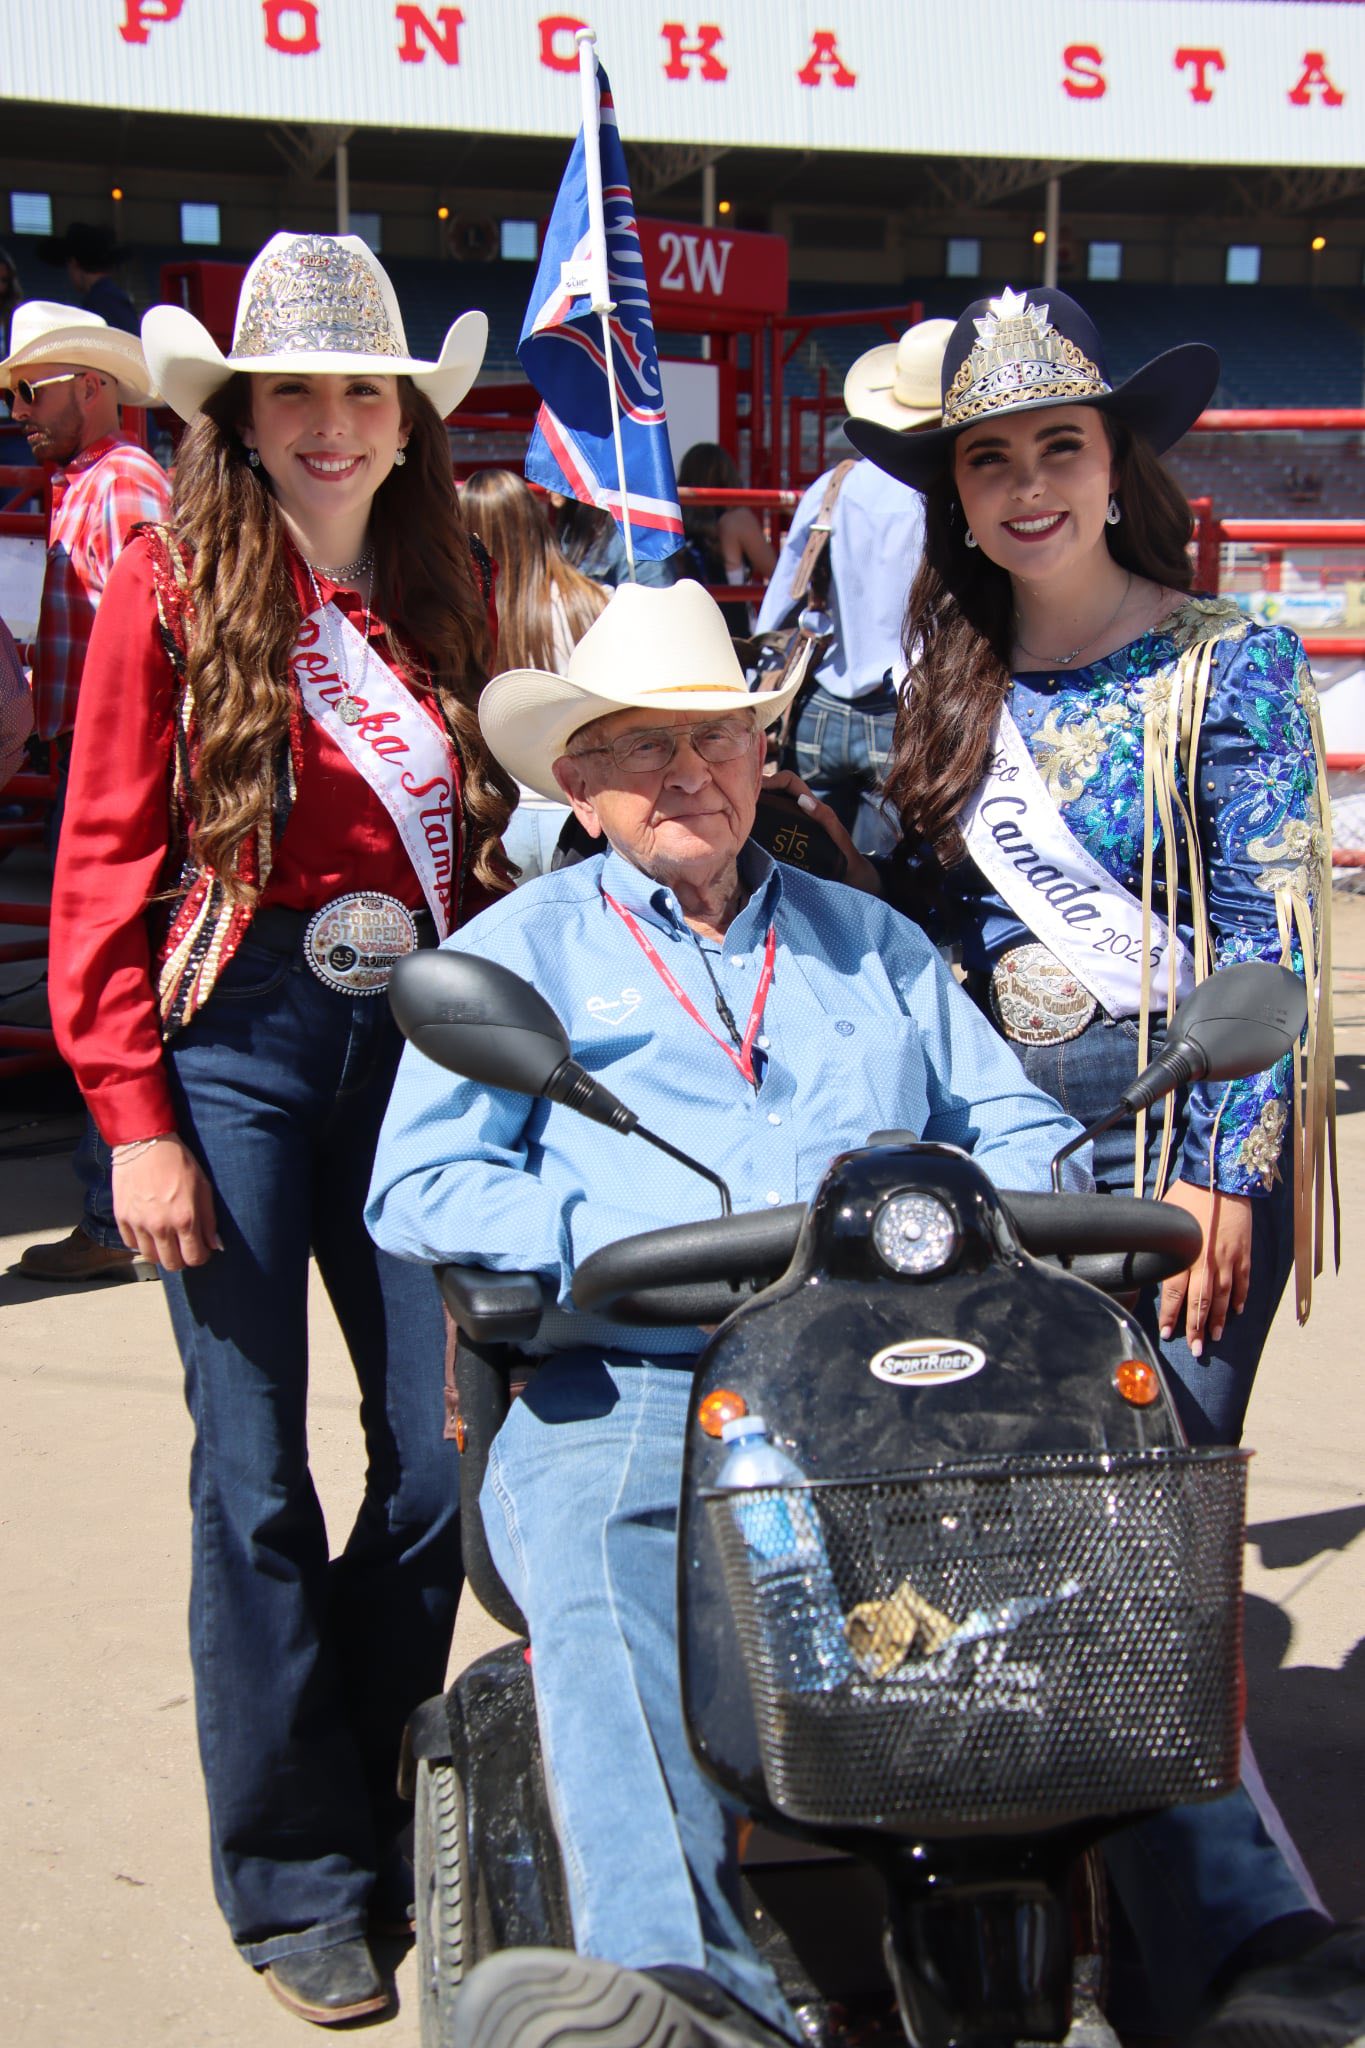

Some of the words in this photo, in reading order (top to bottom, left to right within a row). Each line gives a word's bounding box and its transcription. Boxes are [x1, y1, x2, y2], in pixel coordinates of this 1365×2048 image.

[119, 0, 858, 88] PONOKA
[1061, 44, 1345, 107] STA
[303, 256, 327, 266] 2025
[658, 231, 734, 297] 2W
[980, 796, 1102, 931] Canada
[331, 923, 404, 942] STAMPEDE
